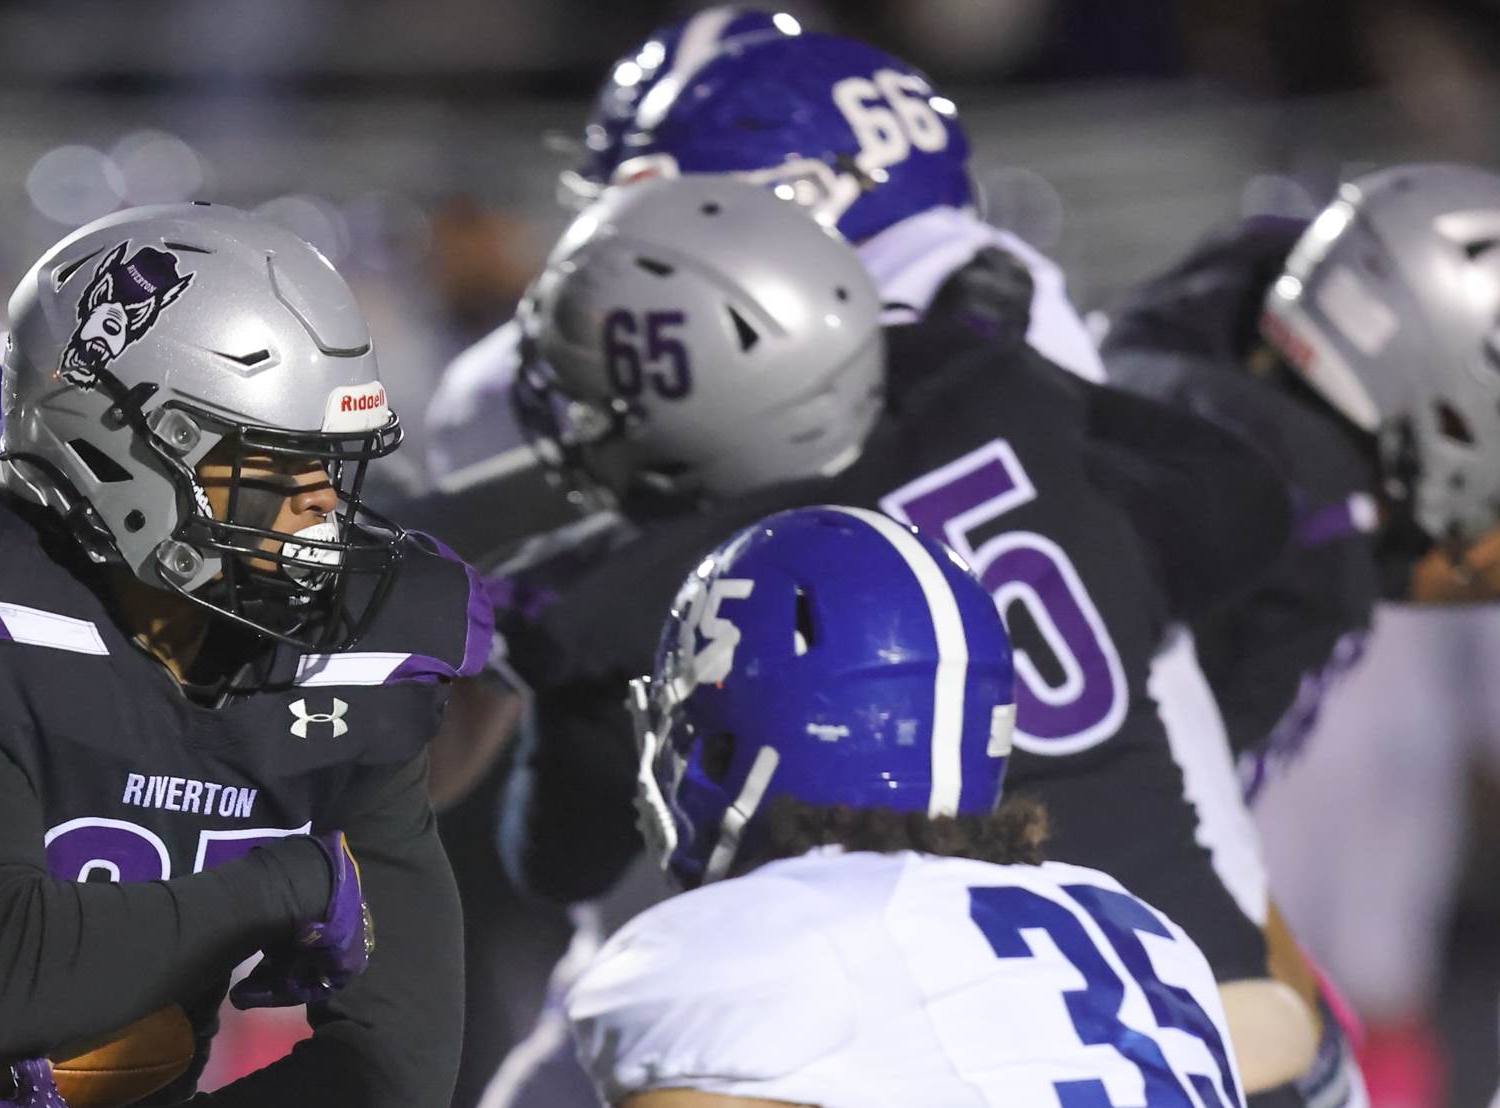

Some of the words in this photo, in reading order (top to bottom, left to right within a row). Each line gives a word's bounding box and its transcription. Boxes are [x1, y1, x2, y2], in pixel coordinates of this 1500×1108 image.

[831, 69, 950, 168] 66
[127, 264, 157, 294] RIVERTON
[605, 309, 692, 400] 65
[340, 388, 385, 412] Riddell
[122, 772, 257, 818] RIVERTON
